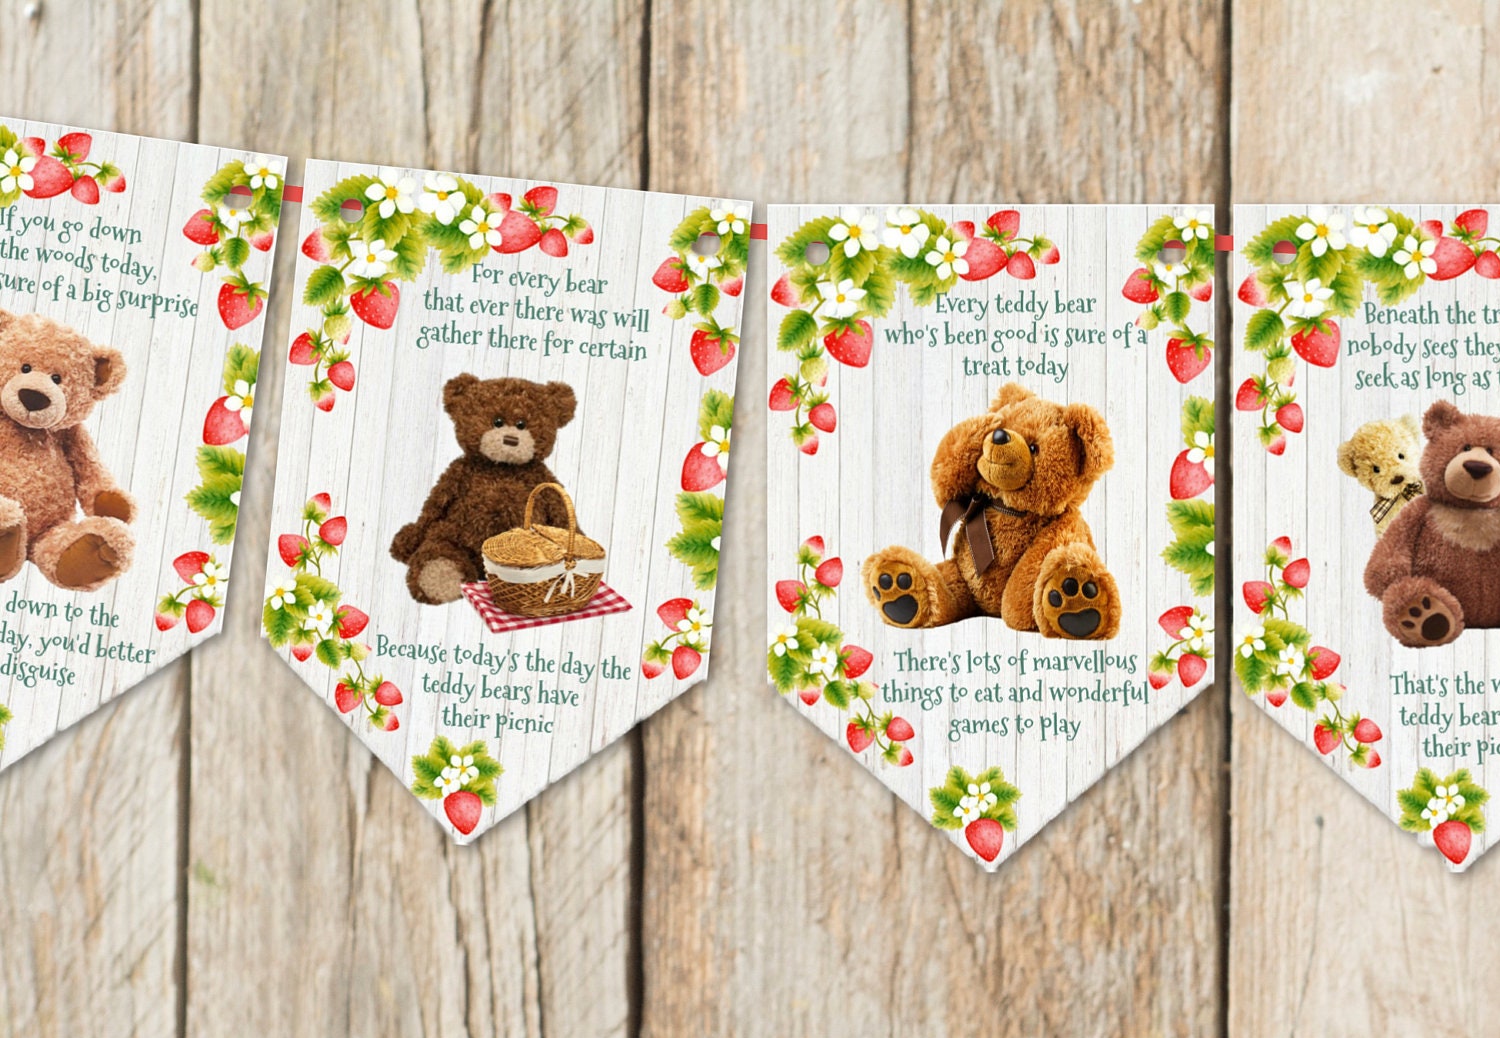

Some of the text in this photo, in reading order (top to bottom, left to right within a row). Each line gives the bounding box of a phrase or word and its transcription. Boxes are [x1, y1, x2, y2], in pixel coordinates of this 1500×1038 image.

[0, 205, 142, 245] If you go down
[0, 235, 157, 285] the woods today,
[42, 275, 64, 301] of
[67, 284, 76, 300] a
[83, 278, 113, 312] big
[116, 290, 198, 319] surprise
[472, 263, 608, 298] For every bear
[424, 287, 649, 332] that ever there was will
[936, 290, 1096, 322] Every teddy bear
[1363, 301, 1440, 325] Beneath
[1445, 300, 1476, 325] the
[416, 320, 647, 361] gather there for certain
[884, 320, 1147, 352] who's been good is sure of a
[1347, 332, 1417, 364] nobody
[1422, 338, 1458, 359] sees
[962, 352, 1069, 383] treat today
[1355, 362, 1399, 390] seek
[1401, 370, 1420, 389] as
[1426, 366, 1466, 395] long
[1472, 370, 1491, 390] as
[6, 590, 119, 627] down to the
[35, 632, 91, 656] you'd
[96, 634, 156, 663] better
[376, 634, 631, 683] Because today's the day the
[894, 648, 1137, 675] There's lots of marvellous
[0, 652, 75, 688] disguise
[1390, 671, 1449, 697] That's
[1454, 671, 1485, 695] the
[422, 671, 581, 707] teddy bears have
[881, 679, 1149, 711] things to eat and wonderful
[442, 704, 553, 738] their picnic
[948, 712, 1081, 742] games to play
[1399, 702, 1453, 735] teddy
[1422, 732, 1471, 758] their
